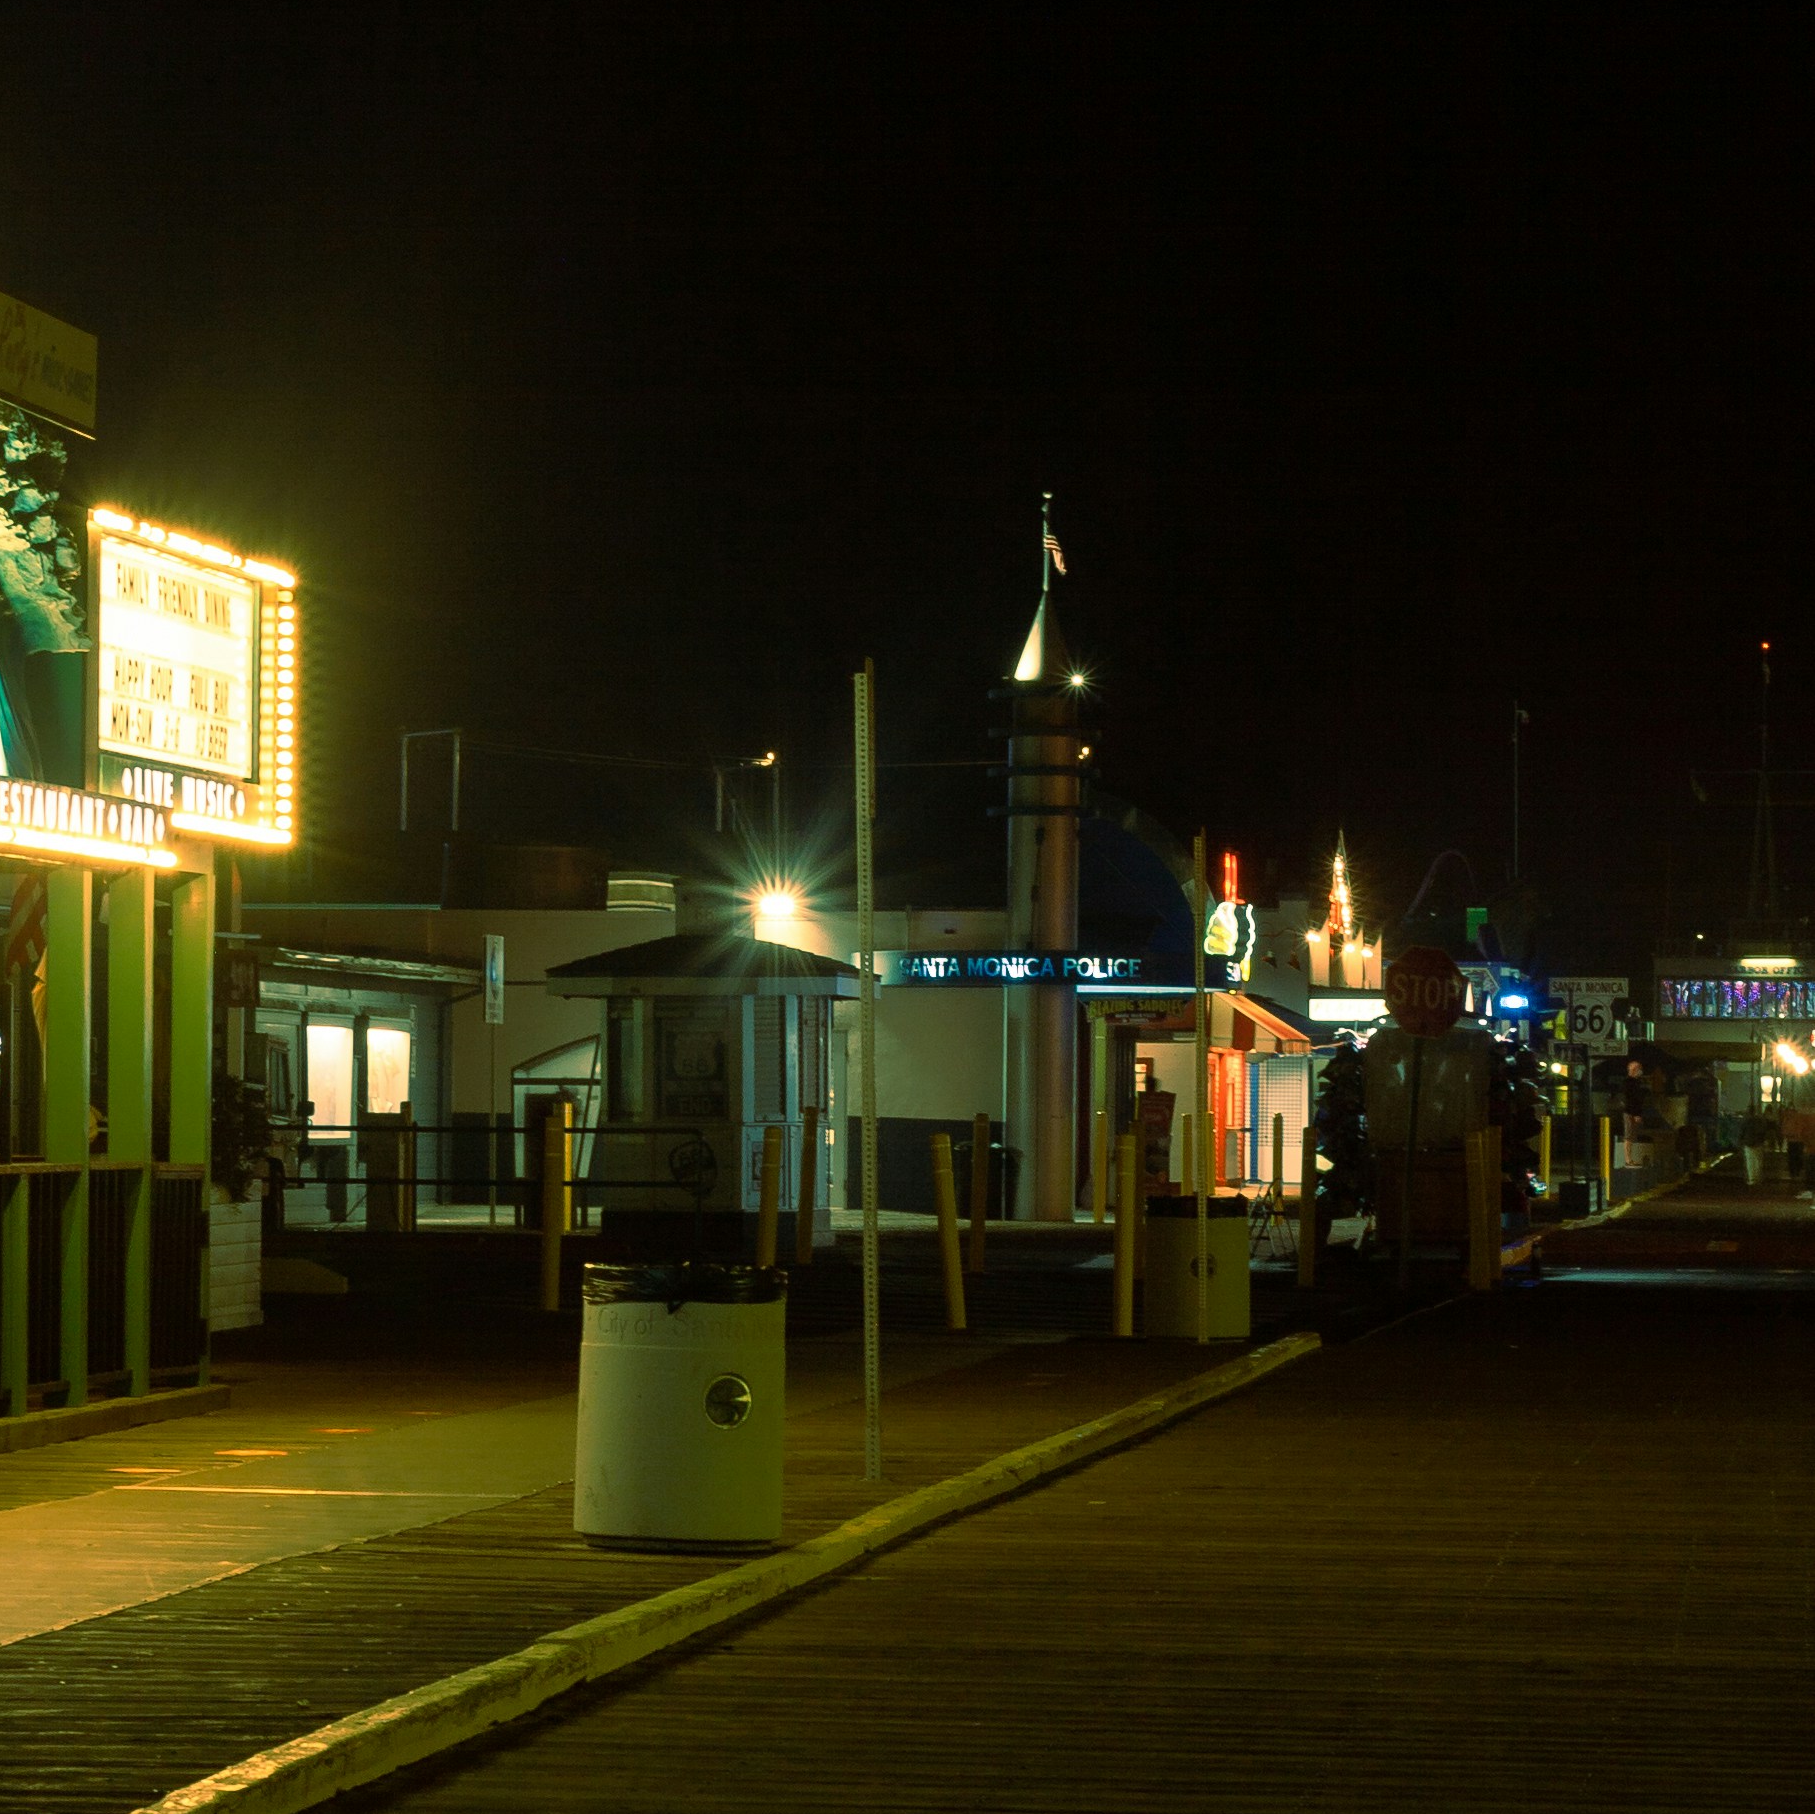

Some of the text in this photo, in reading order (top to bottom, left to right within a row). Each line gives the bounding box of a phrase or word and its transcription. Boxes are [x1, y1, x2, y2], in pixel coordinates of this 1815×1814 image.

[117, 562, 149, 606] FAMILY
[158, 575, 198, 621] FRIENDLY
[114, 655, 228, 716] HAPPY HOUR FULL BAR
[134, 767, 235, 820] LIVE MUSIC
[120, 803, 155, 846] BAR
[899, 958, 1143, 978] SANTA MONICA POLICE
[1553, 982, 1625, 994] SANTA MONICA
[1391, 973, 1461, 1011] STOP
[1573, 1005, 1605, 1034] 66
